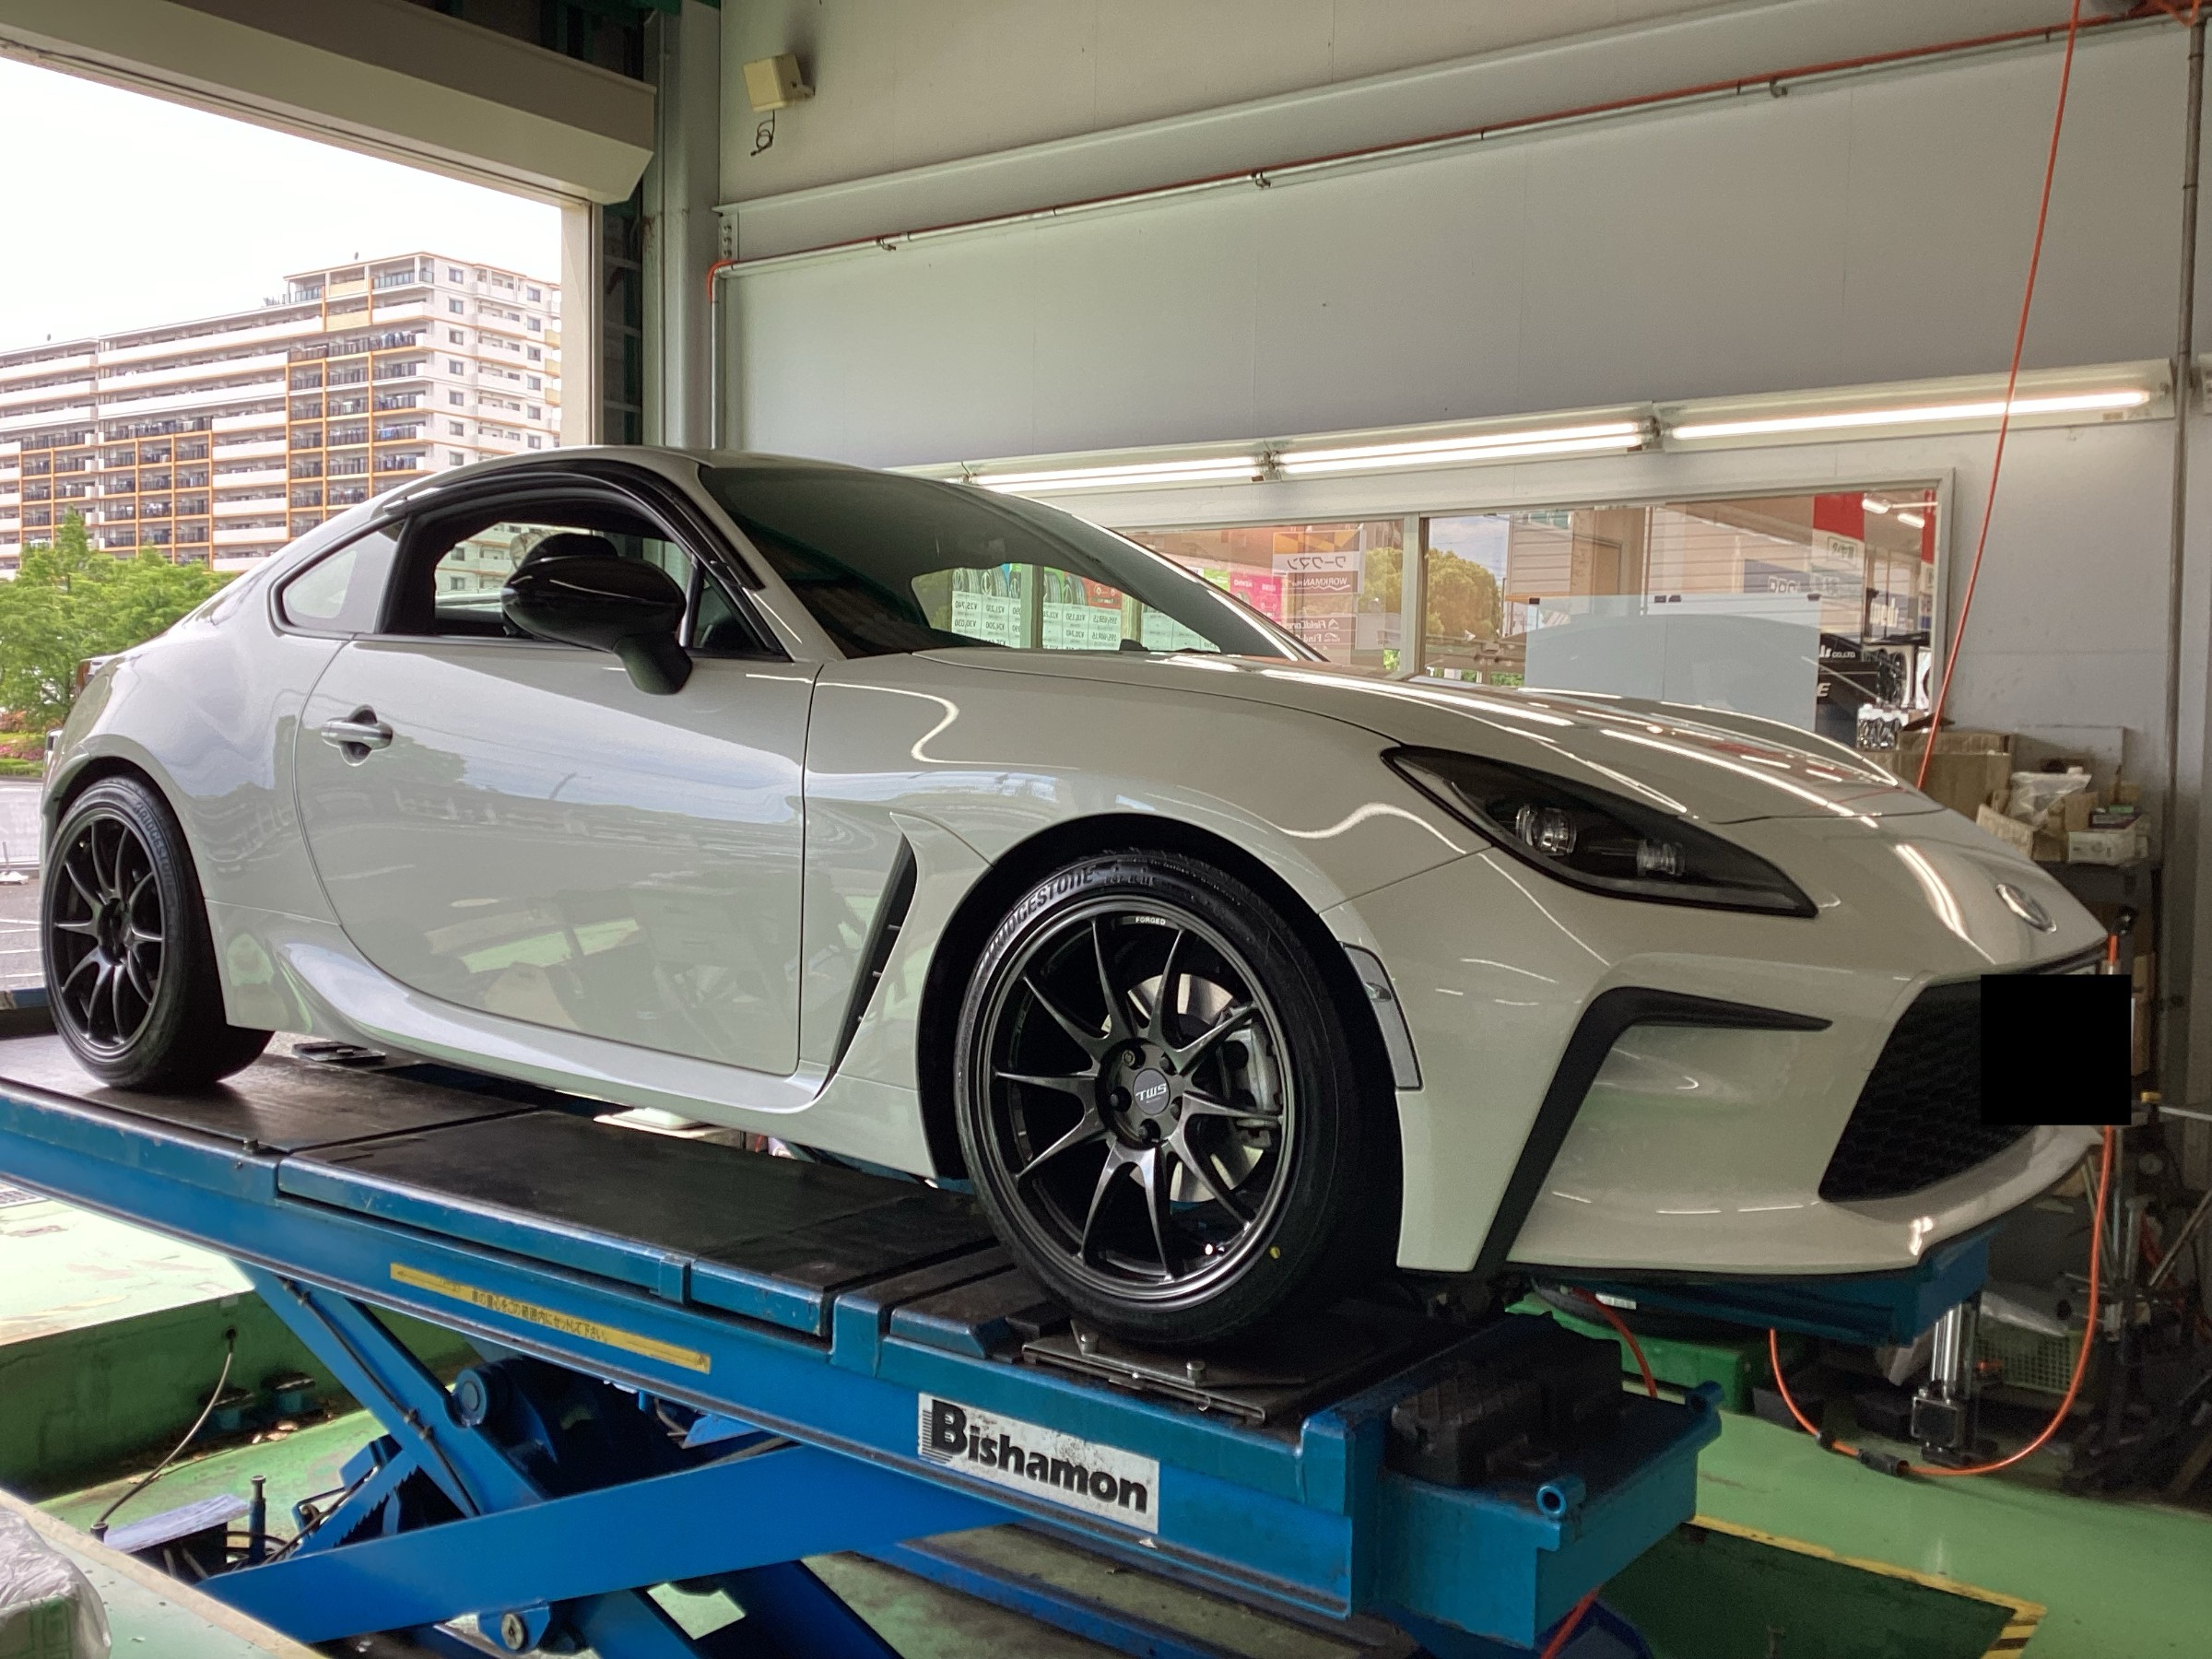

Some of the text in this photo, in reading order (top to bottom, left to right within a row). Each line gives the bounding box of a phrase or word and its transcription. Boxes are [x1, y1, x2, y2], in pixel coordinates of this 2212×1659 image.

[1135, 916, 1166, 925] FORGED
[1135, 1082, 1167, 1101] TWS
[930, 1398, 1148, 1513] Bishamon
